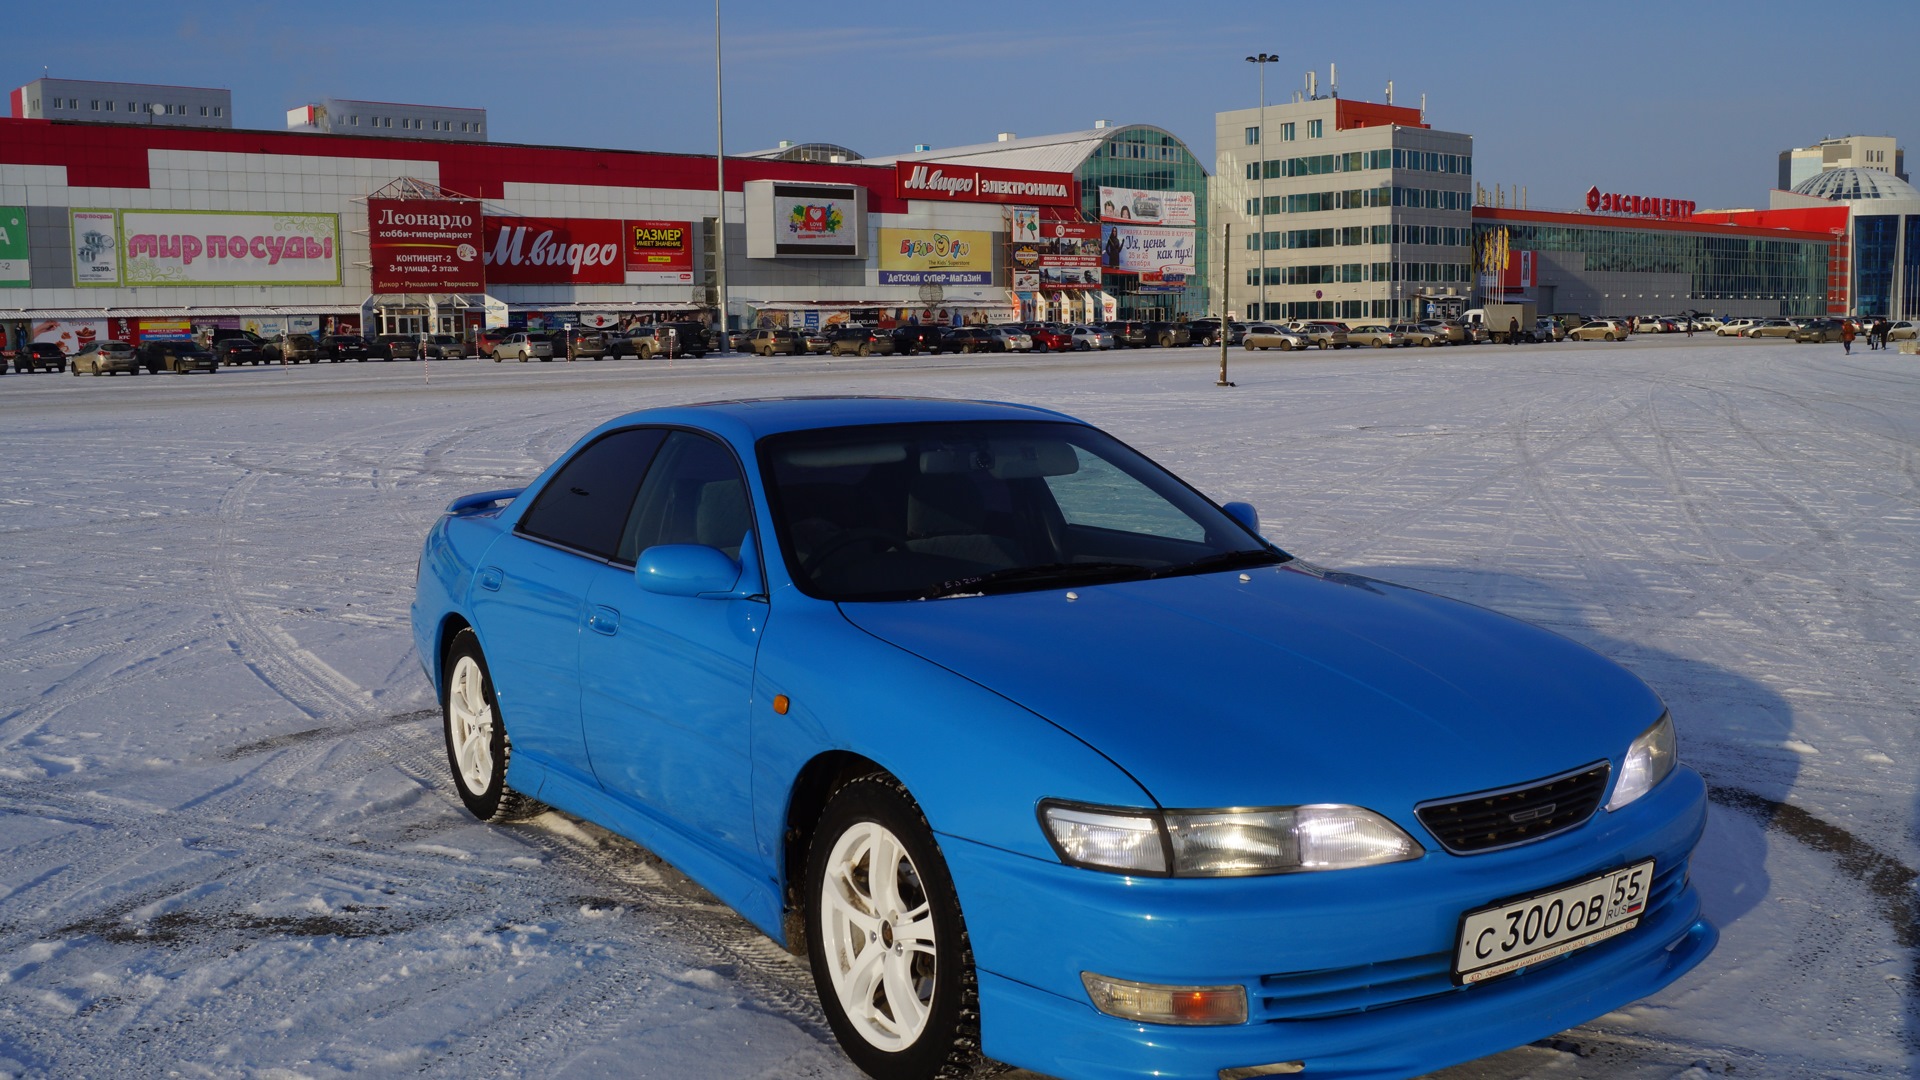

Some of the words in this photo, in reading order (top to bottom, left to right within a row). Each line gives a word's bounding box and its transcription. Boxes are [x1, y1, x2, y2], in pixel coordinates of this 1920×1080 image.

[904, 165, 973, 197] М.видео
[981, 180, 1068, 198] ЭЛЕКТРОНИКА
[1601, 192, 1696, 219] ЭКСПОЦЕНТР
[378, 209, 473, 230] Леонардо
[379, 229, 473, 240] хобби-гипермаркет
[636, 228, 681, 241] РАЗМЕР
[485, 225, 617, 275] М.видео
[1143, 238, 1166, 252] цены
[1157, 249, 1173, 259] как
[1174, 244, 1194, 264] пух!
[389, 264, 402, 272] 3-я
[404, 265, 430, 273] улица,
[432, 264, 437, 272] 2
[1612, 869, 1643, 906] 55
[1606, 904, 1627, 920] RUS
